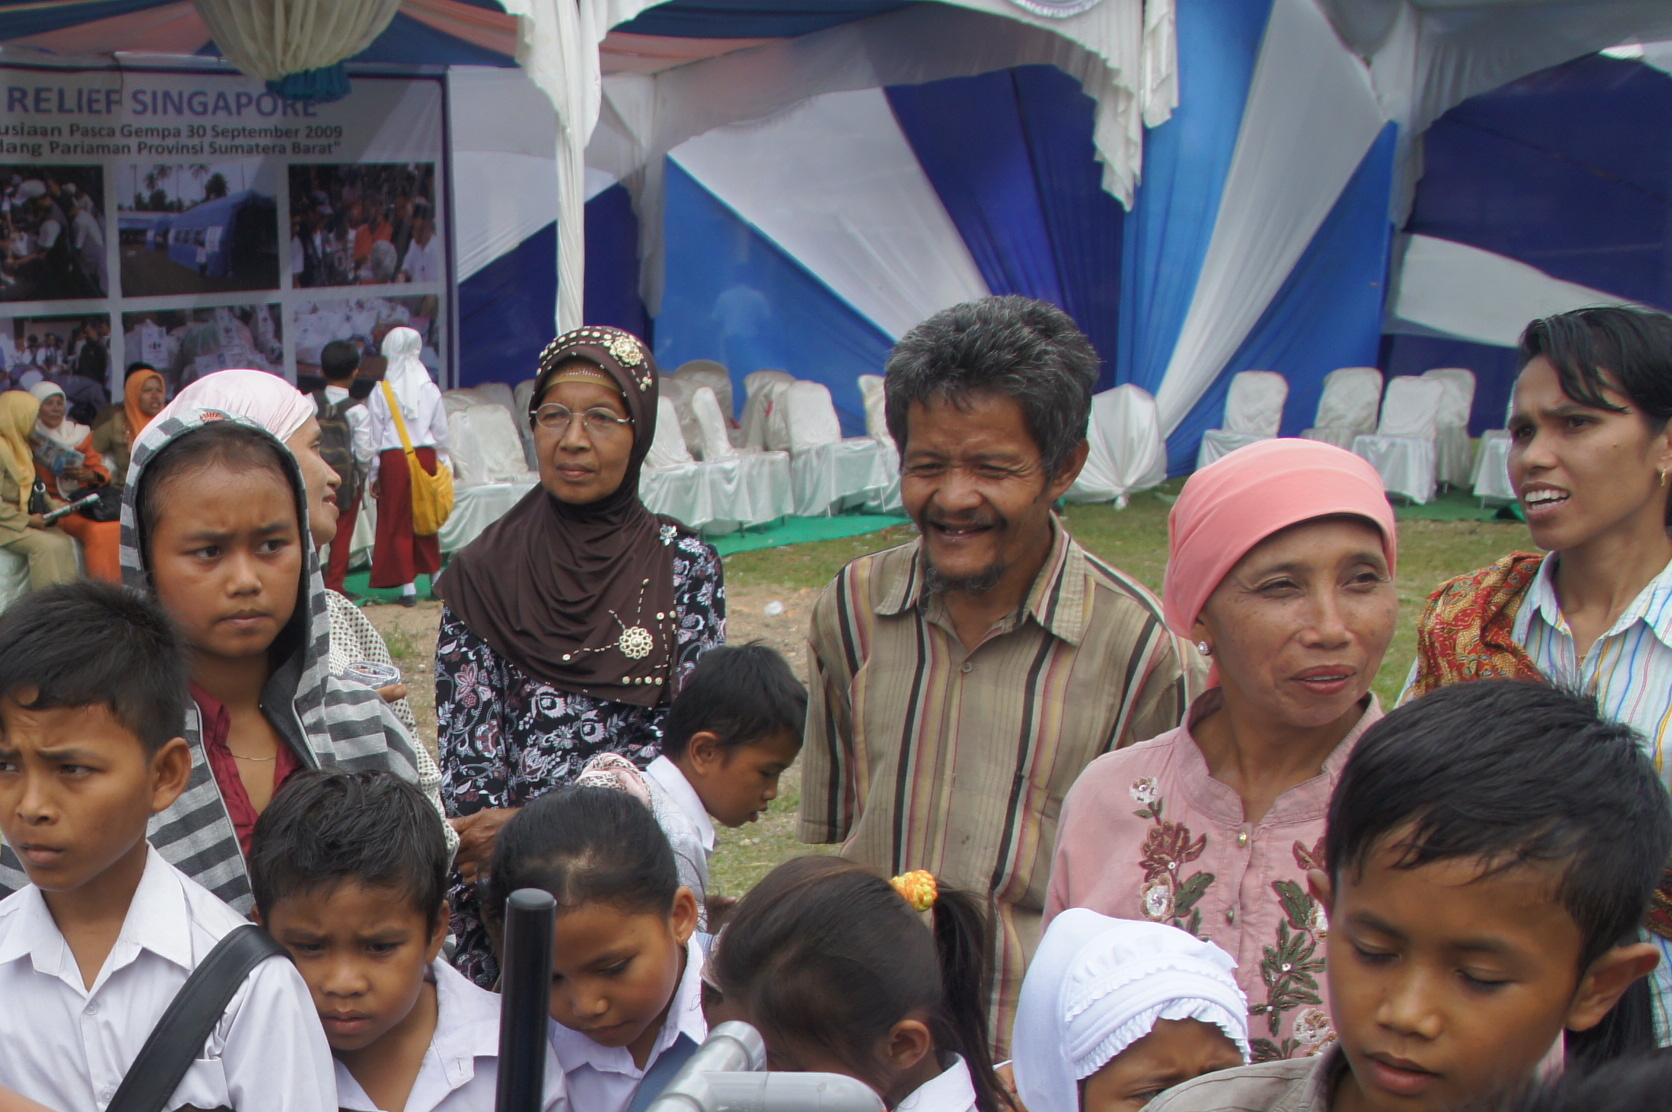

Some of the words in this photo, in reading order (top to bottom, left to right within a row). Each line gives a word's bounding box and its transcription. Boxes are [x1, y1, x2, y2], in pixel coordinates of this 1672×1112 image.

[7, 86, 122, 114] RELIEF
[132, 89, 318, 117] SINGAPORE
[69, 123, 116, 138] Pasca
[120, 124, 182, 140] Gempa
[187, 124, 207, 138] 30
[212, 124, 300, 141] September
[305, 125, 343, 139] 2009
[49, 140, 131, 156] Pariaman
[137, 140, 204, 155] Provinsi
[209, 140, 287, 155] Sumatera
